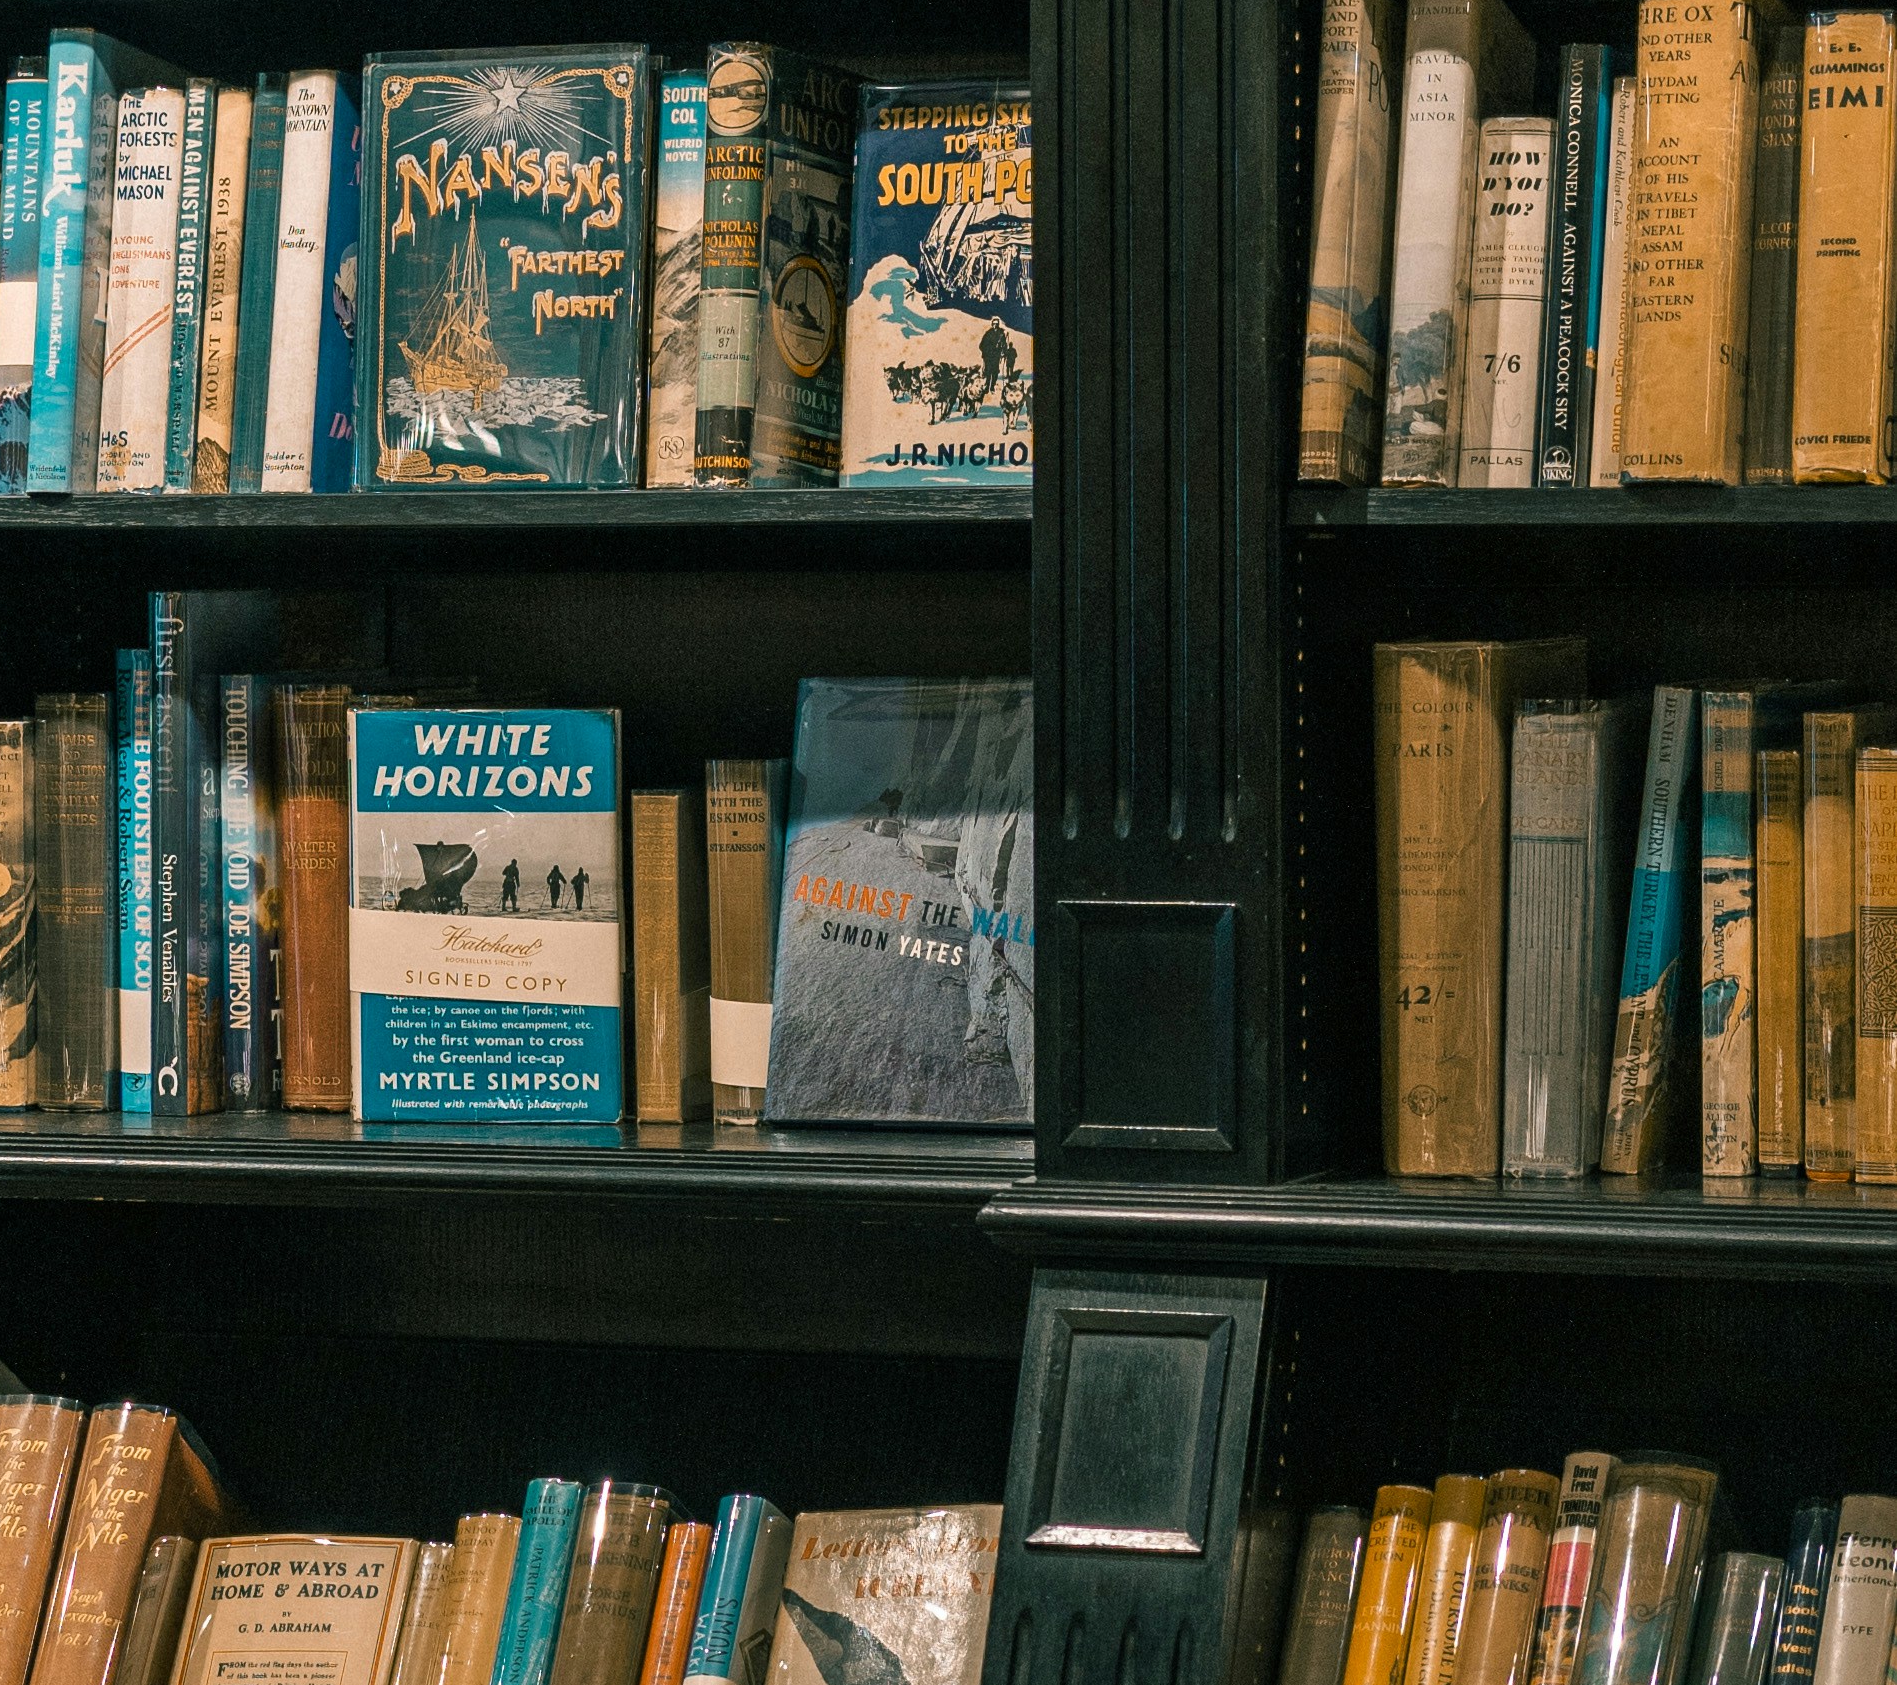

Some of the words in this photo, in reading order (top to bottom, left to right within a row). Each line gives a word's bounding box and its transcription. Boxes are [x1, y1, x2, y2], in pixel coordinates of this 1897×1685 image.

[1808, 84, 1884, 110] EIMI
[121, 112, 168, 127] ARCTIC
[878, 103, 988, 128] STEPPING
[119, 131, 177, 148] FORESTS
[118, 165, 172, 181] MICHAEL
[877, 162, 982, 204] SOUTH
[117, 183, 164, 200] MASON
[217, 176, 232, 217] 1938
[391, 139, 623, 241] NANSEN'S
[208, 223, 227, 324] EVEREST
[204, 332, 221, 411] MOUNT
[1483, 354, 1521, 375] 7/6
[1470, 454, 1523, 466] PALLAS
[1623, 452, 1683, 466] COLLINS
[413, 724, 553, 755] WHITE
[373, 765, 593, 796] HORIZONS
[161, 853, 177, 922] Stephen
[795, 874, 913, 920] AGAINST
[922, 900, 959, 928] THE
[821, 921, 889, 951] SIMON
[899, 936, 963, 966] YATES
[161, 930, 177, 1002] Venables
[406, 971, 490, 987] SIGNED
[506, 976, 568, 992] COPY
[392, 1034, 406, 1049] by
[412, 1034, 434, 1047] the
[441, 1034, 469, 1047] first
[474, 1036, 524, 1047] woman
[530, 1036, 543, 1047] to
[548, 1036, 583, 1047] cross
[413, 1052, 435, 1064] the
[441, 1052, 509, 1064] Greenland
[518, 1052, 565, 1067] ice-cap
[379, 1071, 482, 1091] MYRTLE
[489, 1071, 599, 1091] SIMPSON
[215, 1562, 282, 1578] MOTOR
[288, 1562, 348, 1578] WAYS
[356, 1563, 384, 1577] AT
[212, 1583, 268, 1601] HOME
[274, 1582, 290, 1598] &
[297, 1582, 378, 1599] ABROAD
[1842, 1625, 1873, 1636] FYFE
